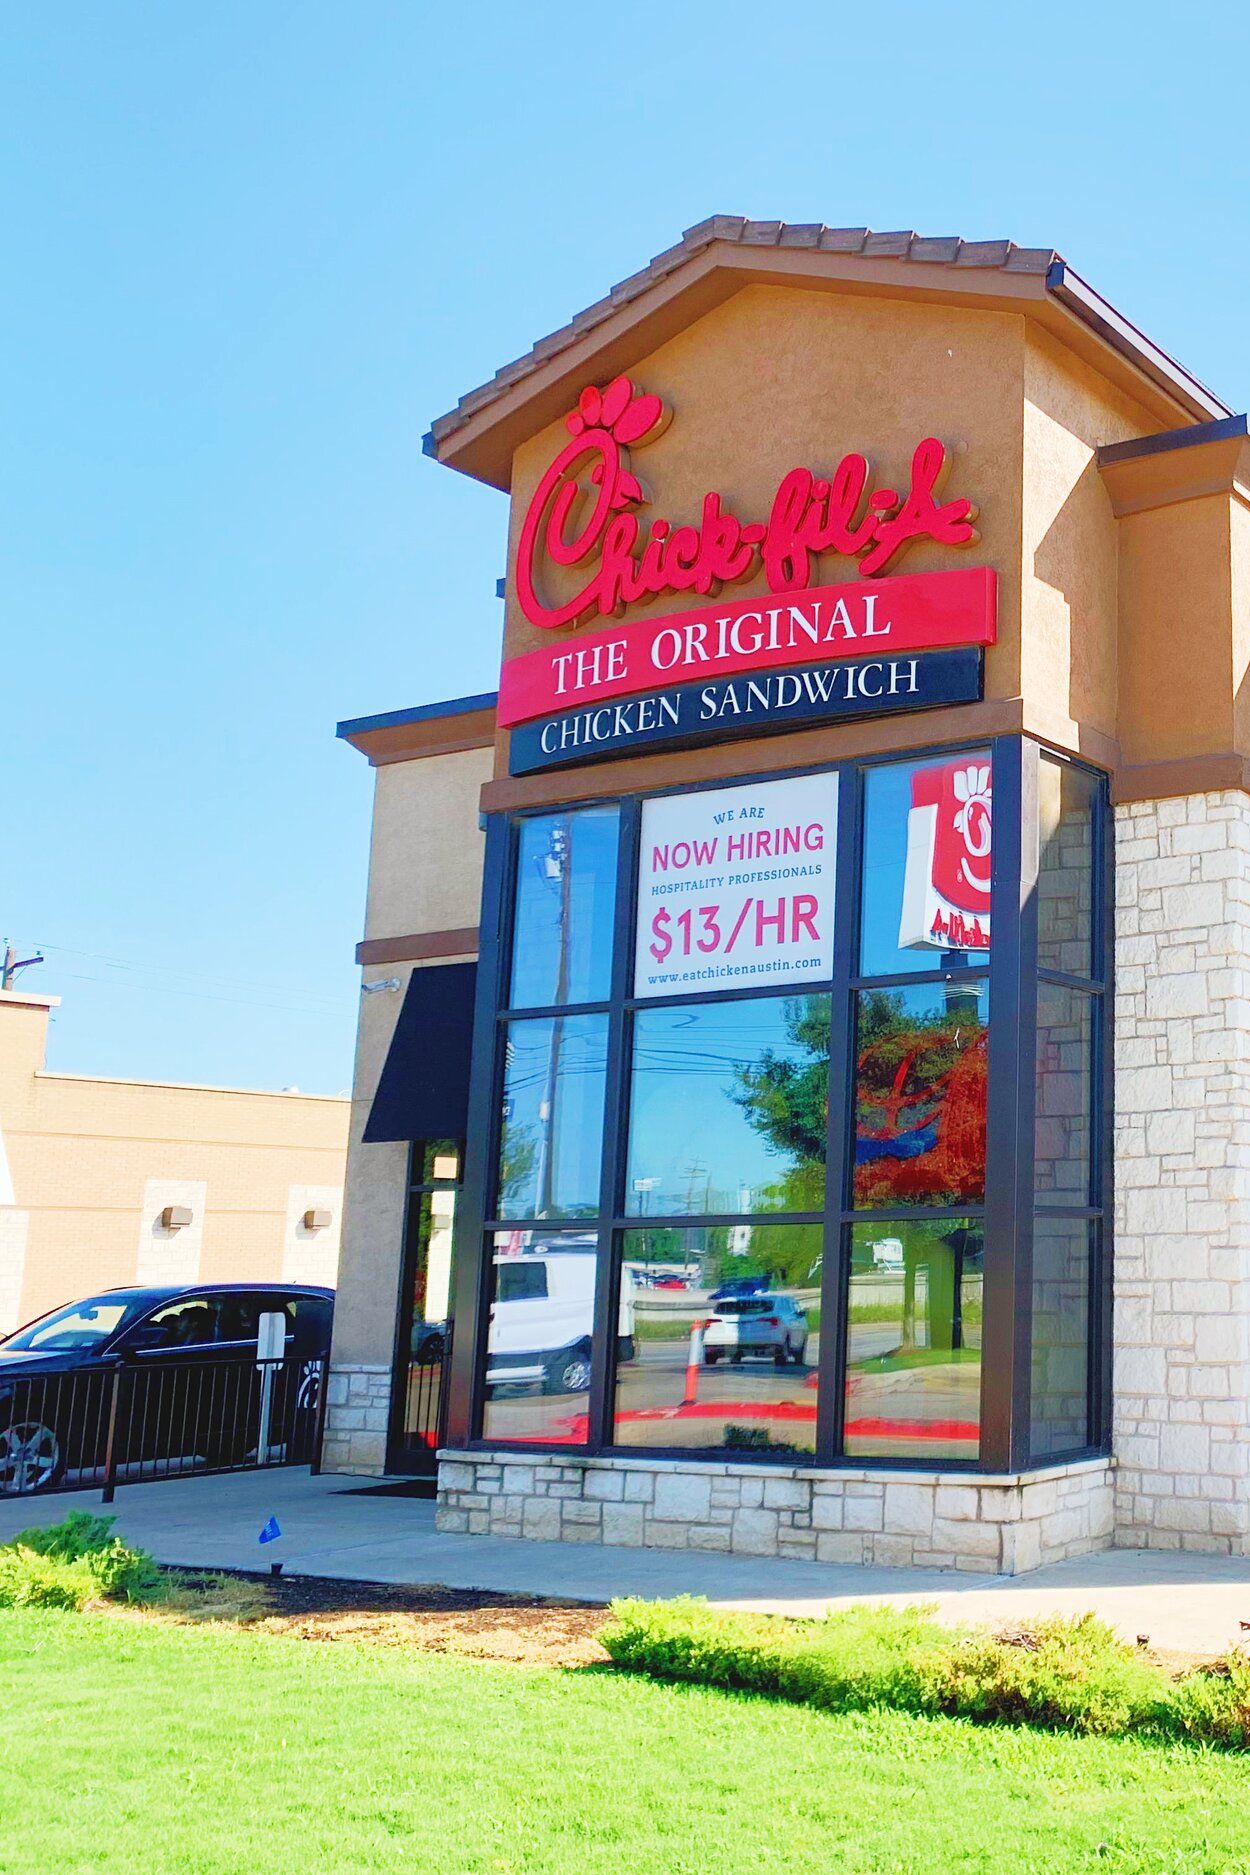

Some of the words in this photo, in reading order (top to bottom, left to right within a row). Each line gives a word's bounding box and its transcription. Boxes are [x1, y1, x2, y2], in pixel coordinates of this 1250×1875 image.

[516, 428, 975, 629] Chick-fil-A
[551, 640, 628, 695] THE
[651, 594, 892, 671] ORIGINAL
[540, 693, 682, 755] CHICKEN
[699, 659, 920, 721] SANDWICH
[713, 810, 735, 825] WE
[739, 807, 765, 819] ARE
[652, 837, 718, 873] NOW
[727, 823, 824, 862] HIRING
[651, 876, 725, 896] HOSPITALITY
[728, 864, 822, 886] PROFESSIONALS
[649, 894, 821, 964] $13/HR
[648, 958, 822, 985] www.eatchickenaustin.com
